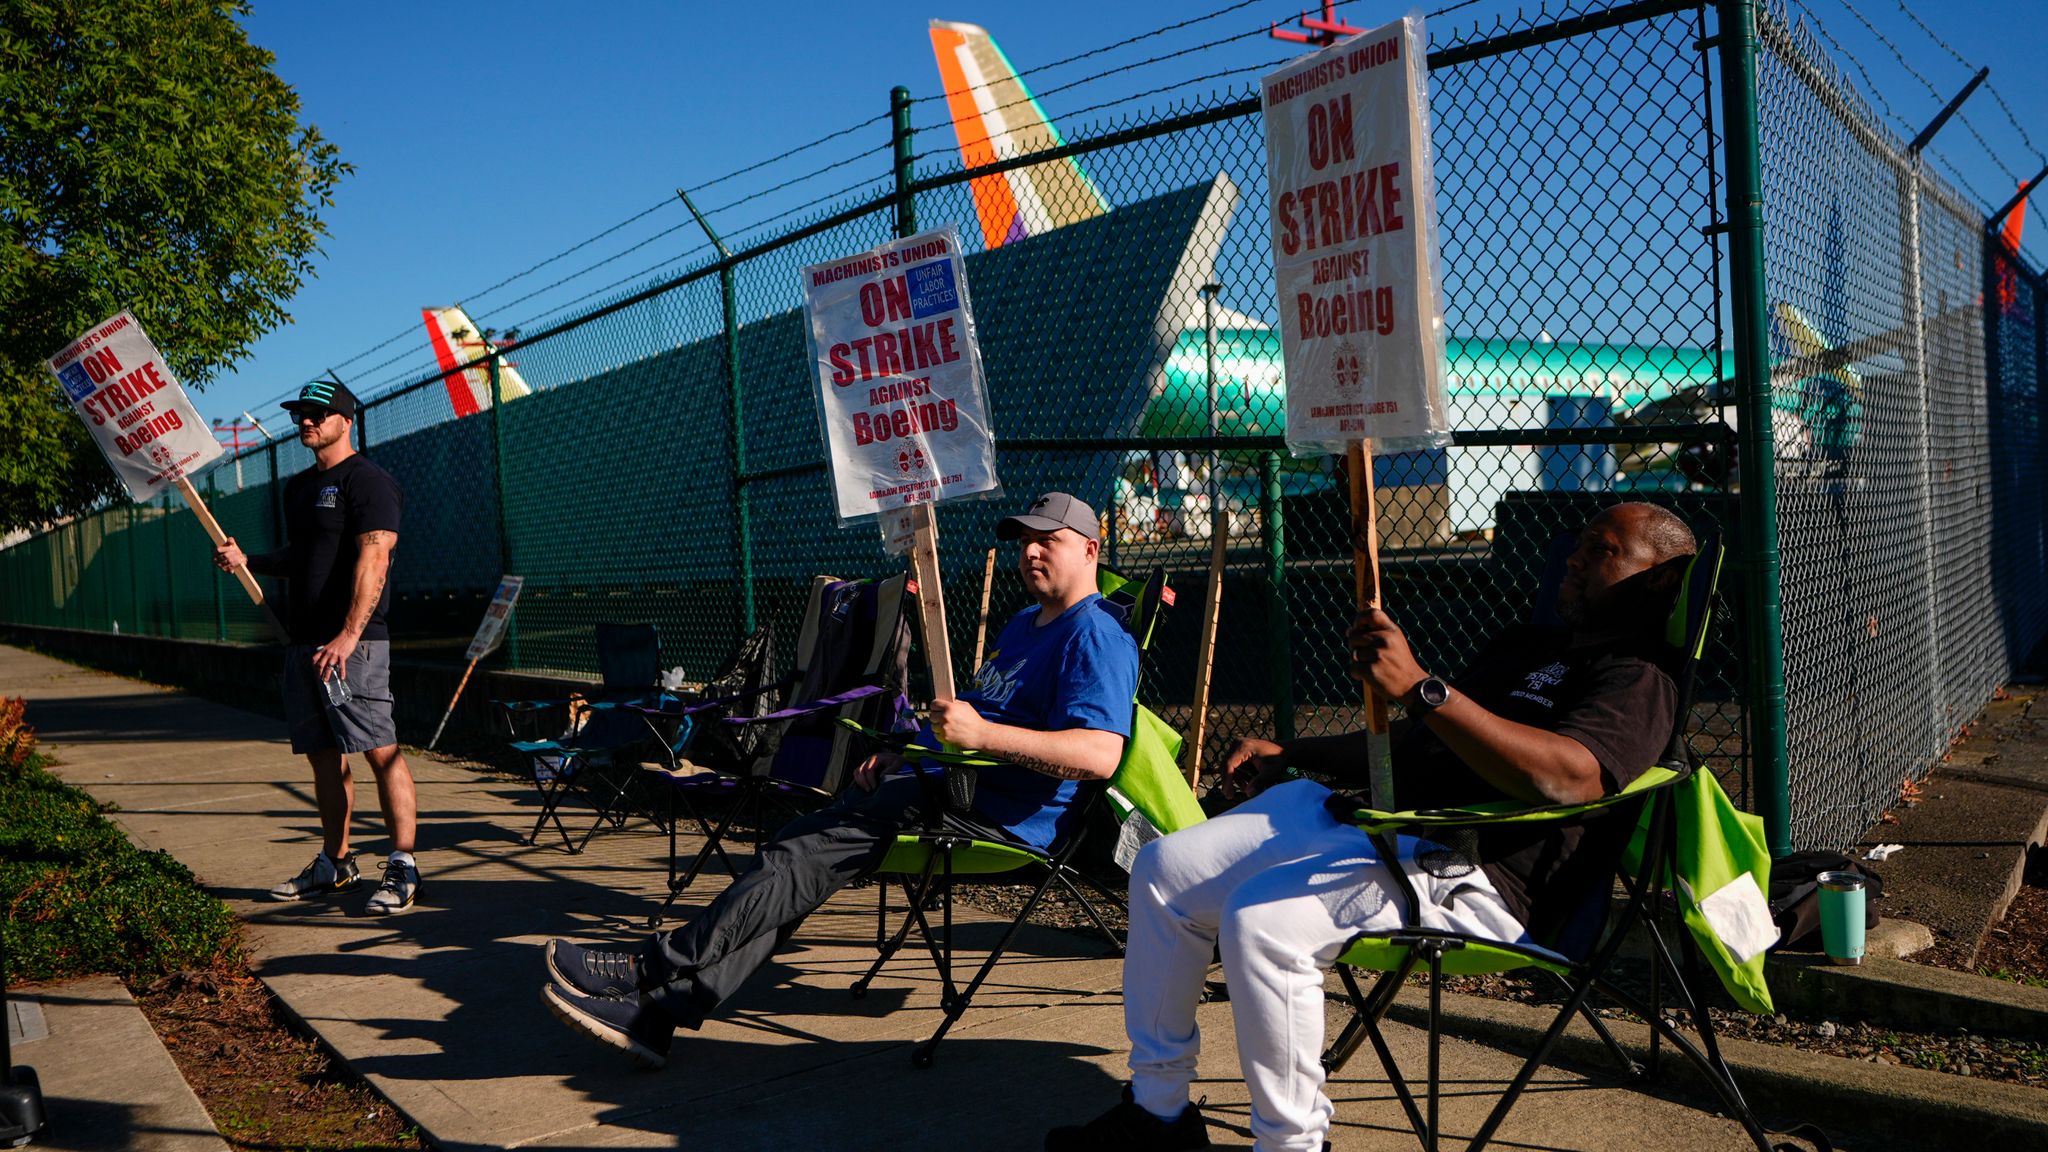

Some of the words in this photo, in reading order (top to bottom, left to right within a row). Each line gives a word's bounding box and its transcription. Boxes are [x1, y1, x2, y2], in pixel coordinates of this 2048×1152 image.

[1268, 56, 1345, 107] MACHINISTS
[1349, 36, 1399, 75] UNION
[1307, 93, 1355, 171] ON
[1278, 162, 1404, 256] STRIKE
[812, 251, 899, 287] MACHINISTS
[901, 239, 947, 264] UNION
[916, 263, 944, 282] UNFAIR
[919, 277, 945, 294] LABOR
[1312, 249, 1370, 286] AGAINST
[859, 275, 912, 327] ON
[1297, 284, 1395, 341] Boeing
[52, 333, 101, 370] MACHINISTS
[98, 316, 130, 339] UNION
[82, 346, 124, 384] ON
[829, 318, 961, 388] STRIKE
[83, 361, 168, 427] STRIKE
[117, 401, 156, 430] AGAINST
[869, 376, 931, 406] AGAINST
[114, 408, 184, 457] Boeing
[852, 398, 960, 447] Boeing
[898, 480, 930, 495] DISTRICT
[930, 476, 951, 489] LOGE
[950, 473, 963, 484] 751
[903, 492, 931, 504] AFL-CIO
